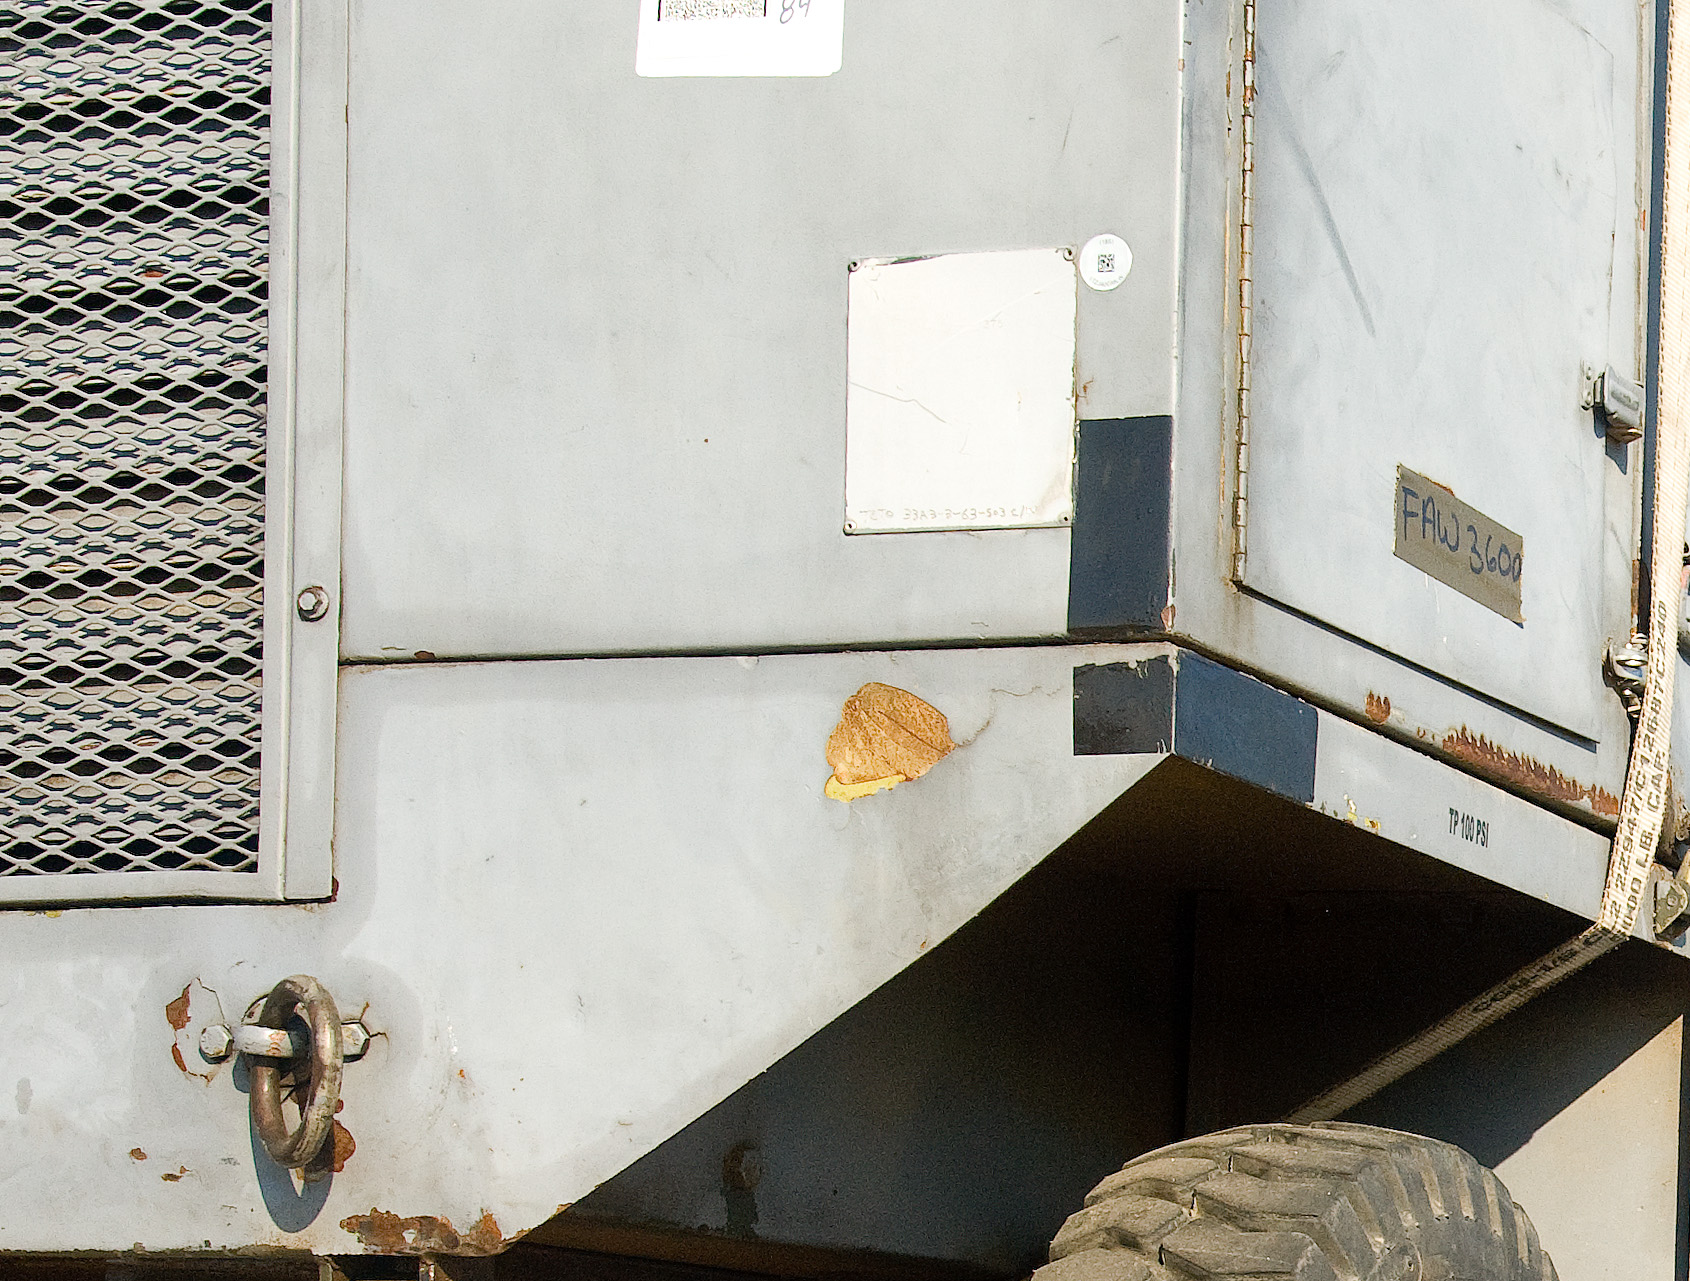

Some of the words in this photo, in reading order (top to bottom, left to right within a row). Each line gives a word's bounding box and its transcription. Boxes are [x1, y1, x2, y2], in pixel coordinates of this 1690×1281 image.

[1401, 486, 1459, 552] FAW
[1467, 525, 1522, 583] 3600
[1449, 807, 1459, 835] TP
[1461, 812, 1475, 842] 100
[1476, 819, 1490, 848] PSI
